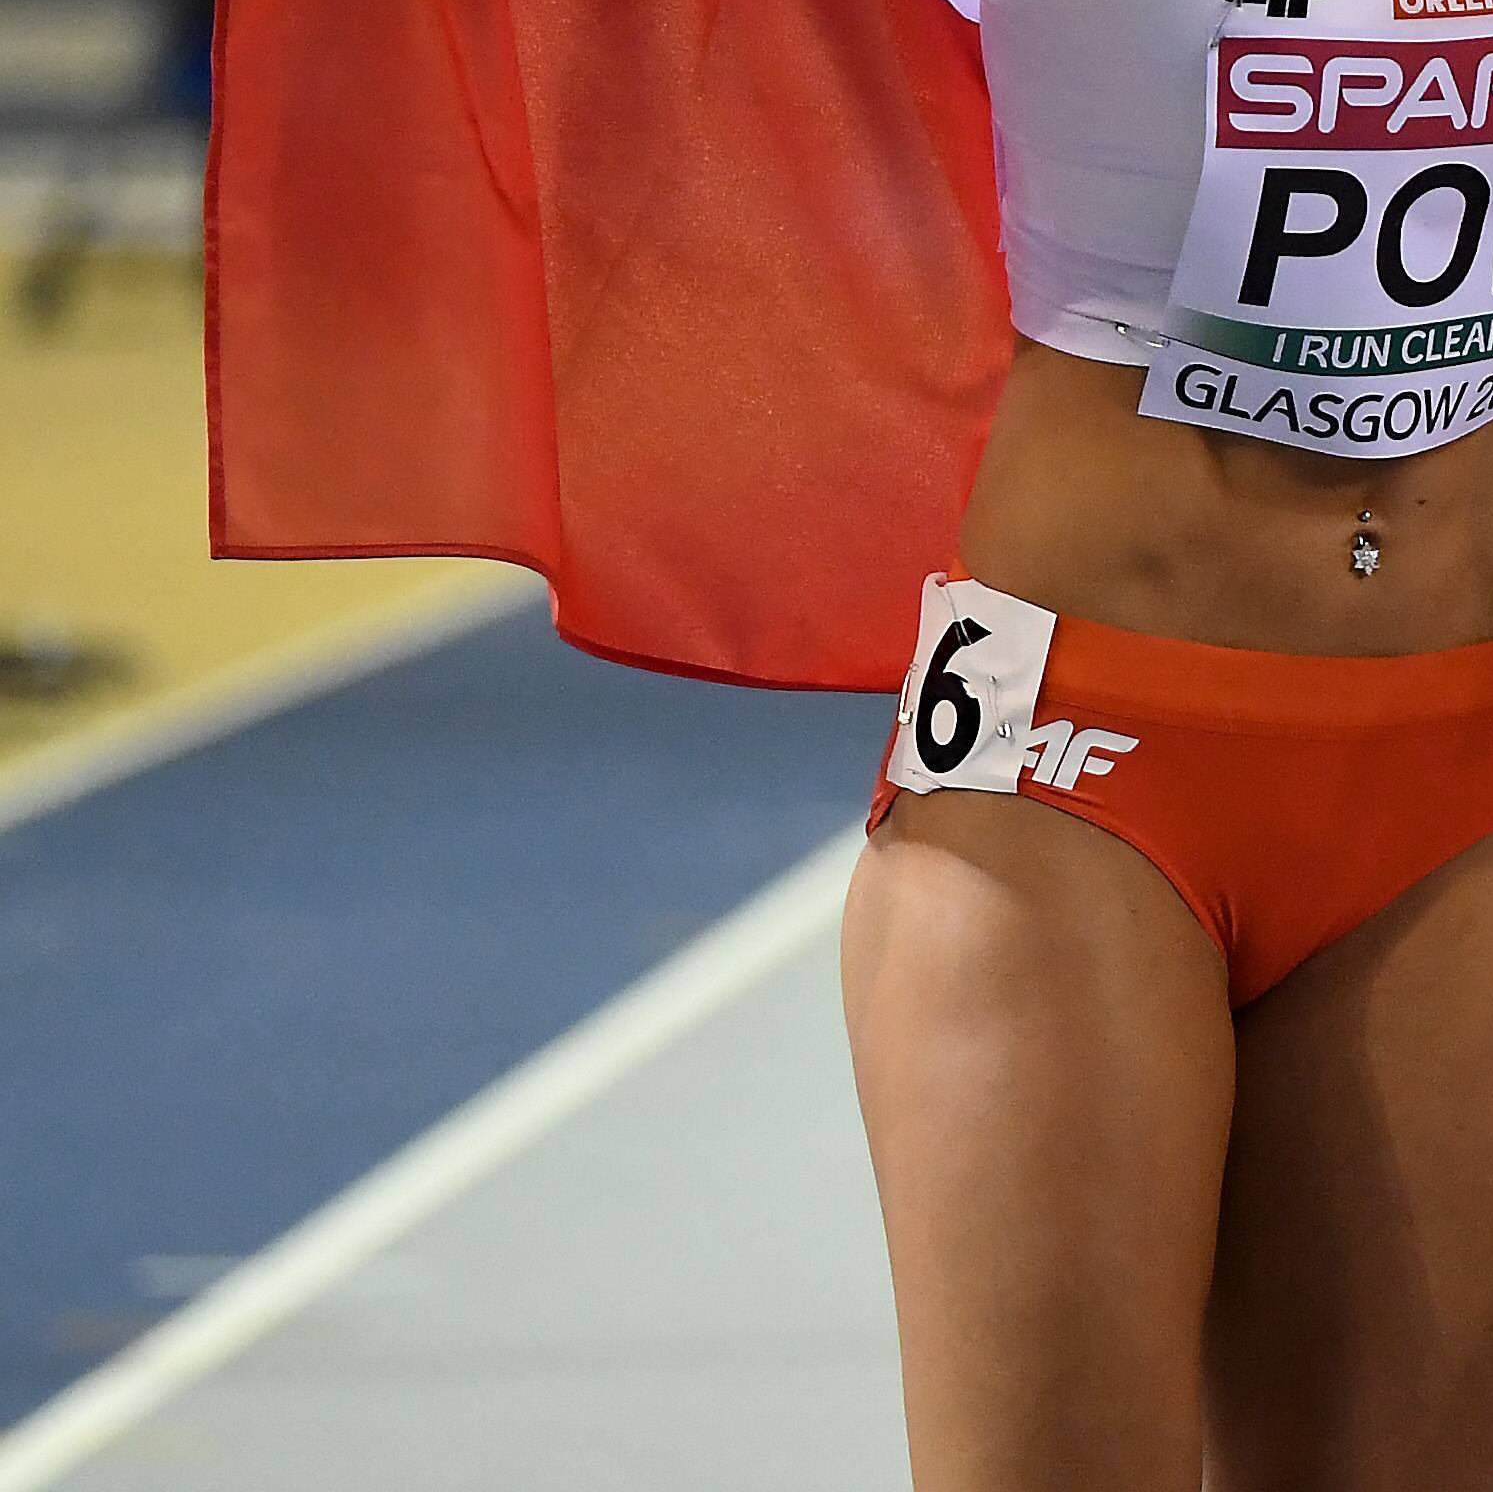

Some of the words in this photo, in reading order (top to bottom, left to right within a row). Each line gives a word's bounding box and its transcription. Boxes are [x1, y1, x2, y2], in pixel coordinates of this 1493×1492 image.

[1272, 333, 1287, 363] I
[1298, 333, 1392, 368] RUN
[1174, 364, 1468, 442] GLASGOW
[915, 616, 992, 774] 6
[1022, 719, 1140, 791] 4F
